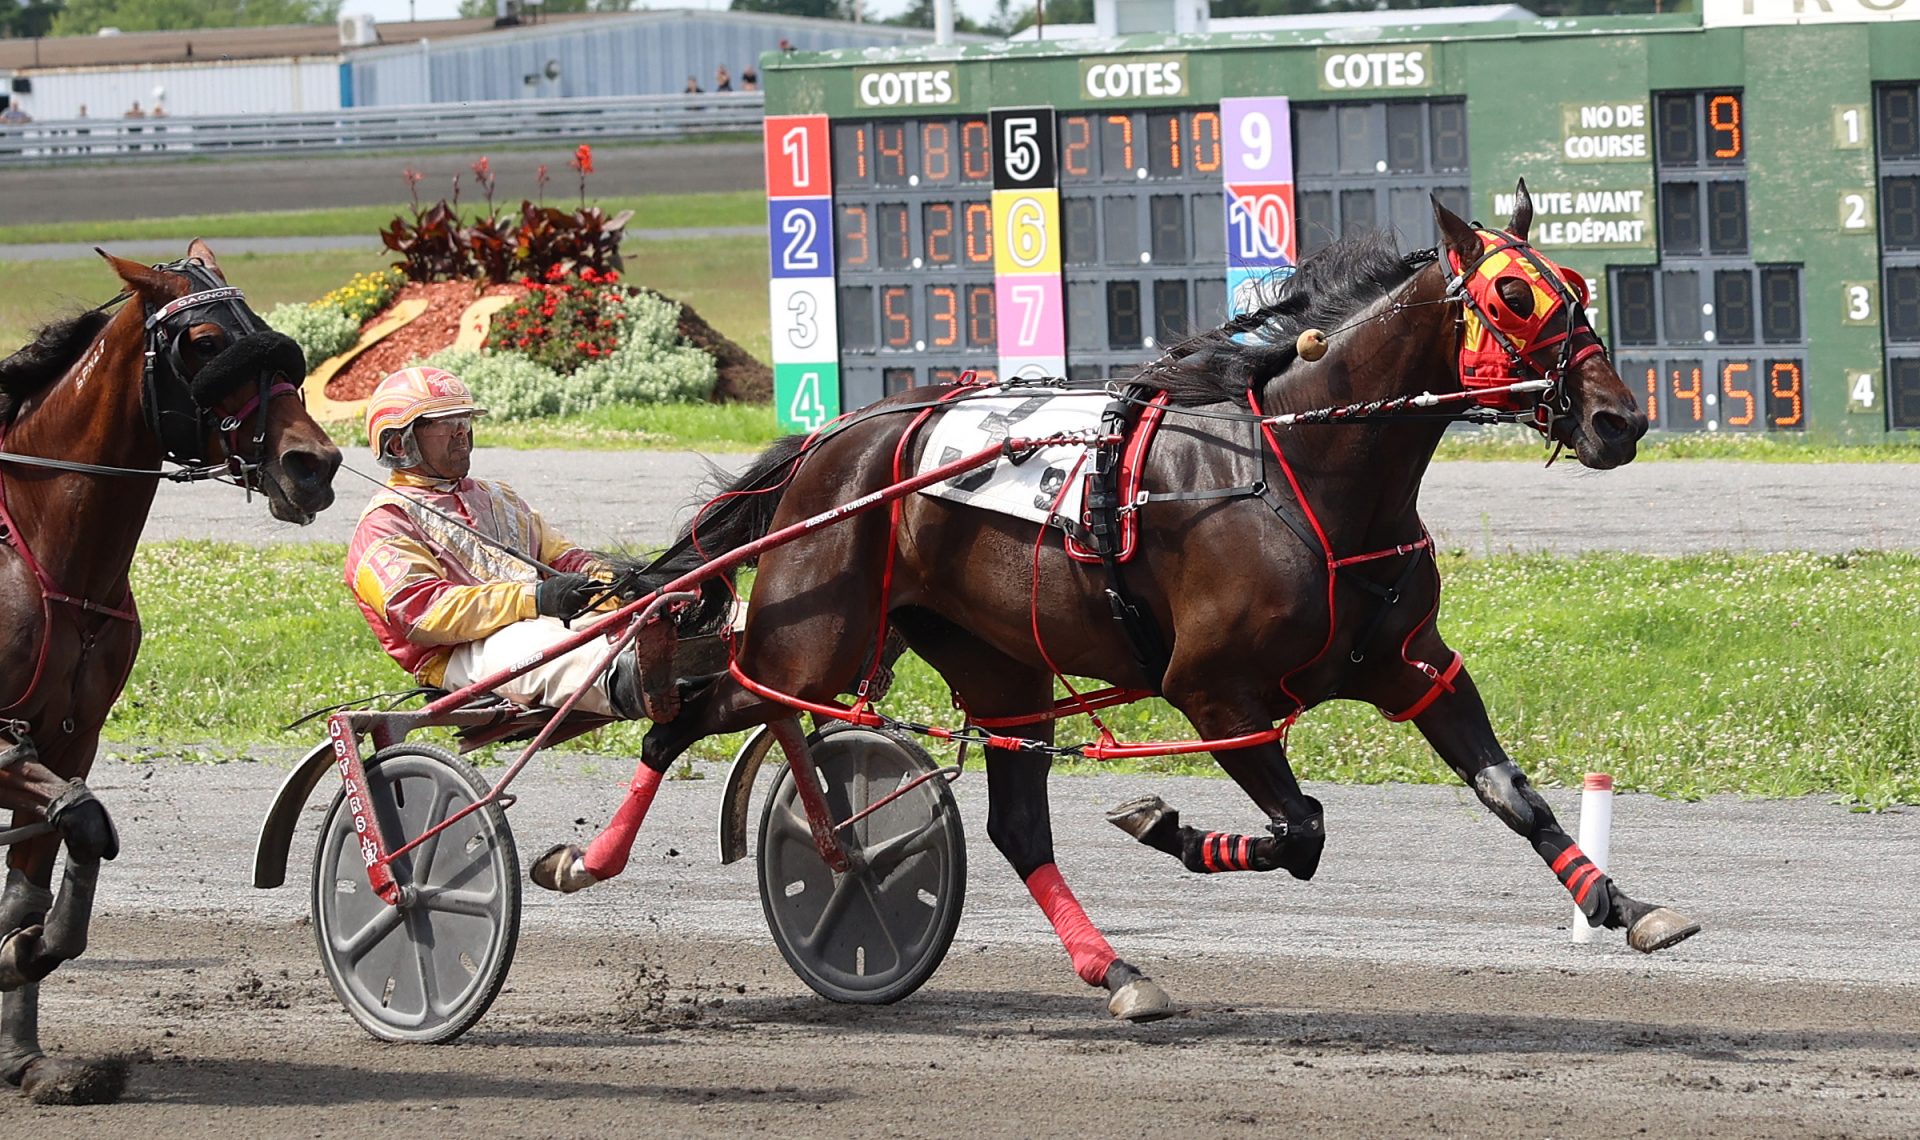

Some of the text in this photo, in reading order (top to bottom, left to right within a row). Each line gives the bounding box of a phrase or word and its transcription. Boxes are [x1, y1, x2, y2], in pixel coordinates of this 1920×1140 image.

[860, 70, 952, 105] COTES
[1086, 62, 1182, 98] COTES
[1324, 51, 1424, 89] COTES
[1581, 105, 1645, 128] NO DE
[1709, 95, 1742, 158] 9
[1843, 110, 1858, 143] 1
[783, 127, 810, 187] 1
[1004, 118, 1041, 181] 5
[1240, 112, 1272, 170] 9
[1564, 135, 1646, 158] COURSE
[1494, 190, 1644, 216] MUTE AVANT
[1845, 194, 1866, 228] 2
[783, 208, 818, 270] 2
[1007, 197, 1047, 267] 6
[1230, 194, 1289, 258] 10
[1540, 217, 1645, 244] LE DÉPART
[177, 289, 232, 307] GAGNON
[1011, 284, 1044, 347] 7
[1850, 286, 1870, 320] 3
[788, 290, 819, 349] 3
[790, 372, 826, 432] 4
[1853, 374, 1874, 407] 4
[805, 508, 839, 528] JESSICA
[366, 544, 413, 592] B
